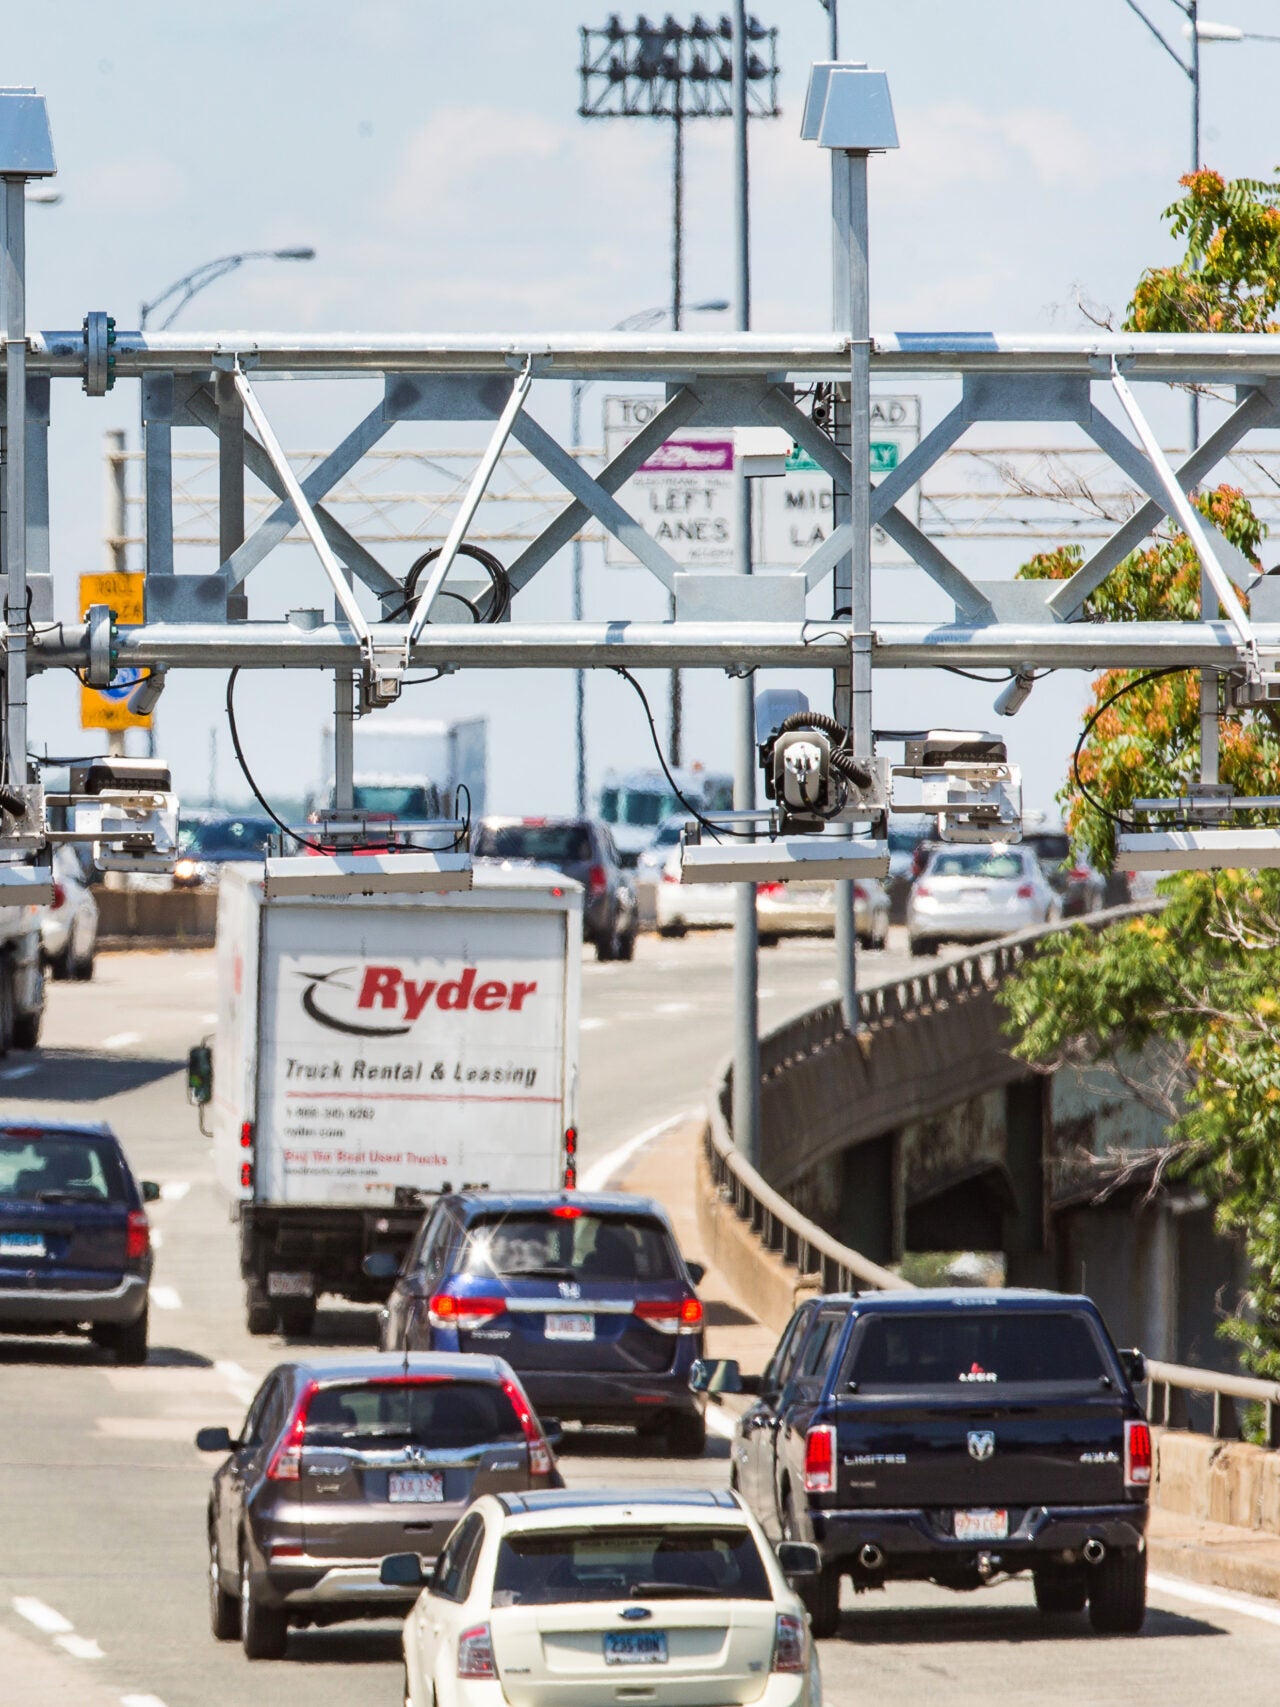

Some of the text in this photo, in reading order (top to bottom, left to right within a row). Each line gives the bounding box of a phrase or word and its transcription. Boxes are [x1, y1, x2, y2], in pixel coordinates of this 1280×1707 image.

[649, 489, 716, 513] LEFT
[783, 489, 833, 511] MID
[639, 517, 730, 542] ANES
[358, 966, 538, 1021] Ryder
[286, 1058, 538, 1088] Truck Rental & Leasing
[369, 1150, 402, 1164] Used
[407, 1151, 448, 1167] Trucks
